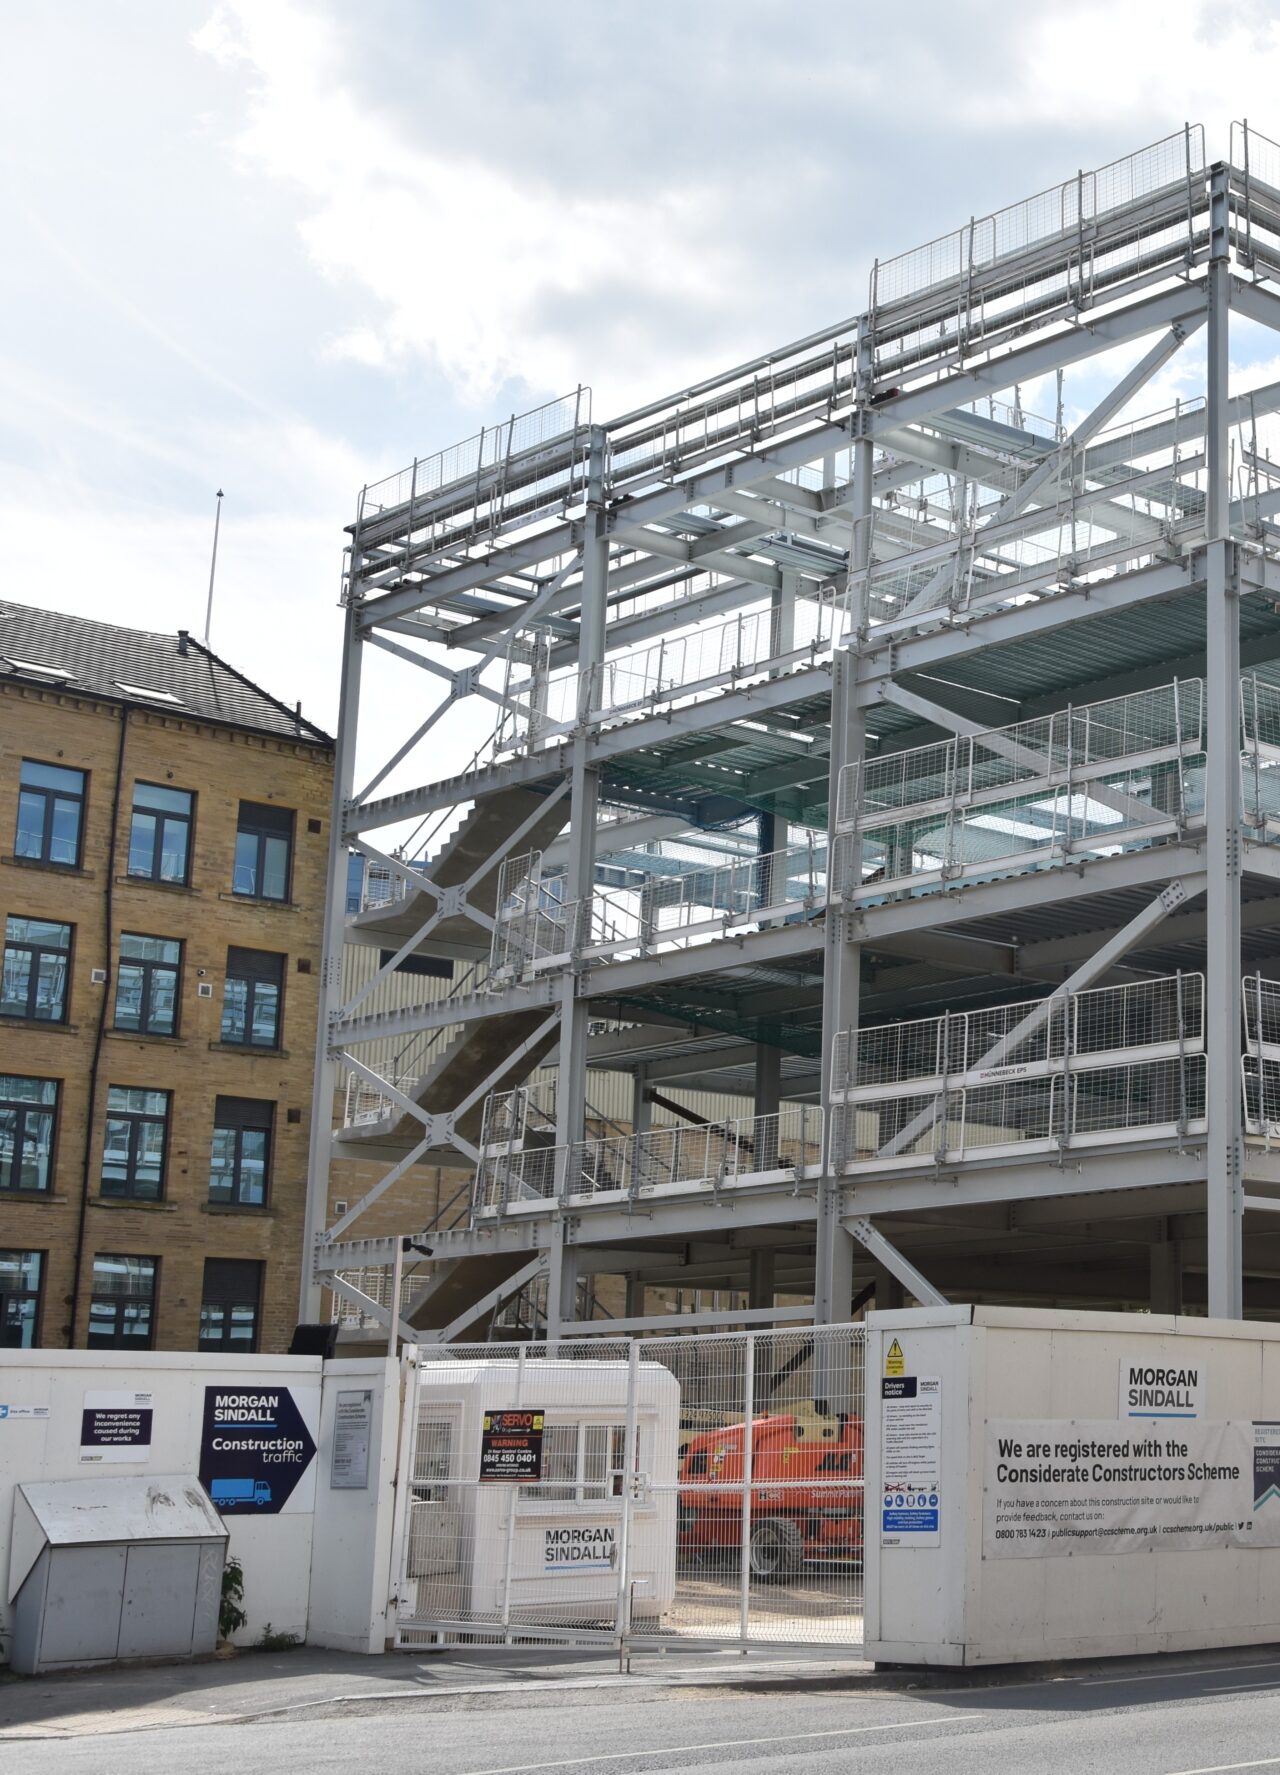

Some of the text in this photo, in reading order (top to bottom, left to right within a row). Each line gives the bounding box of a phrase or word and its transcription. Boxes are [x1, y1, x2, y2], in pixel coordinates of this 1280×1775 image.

[1129, 1368, 1198, 1387] MORGAN
[884, 1382, 905, 1390] Drivers
[215, 1396, 279, 1407] MORGAN
[1128, 1389, 1194, 1407] SINDALL
[107, 1413, 128, 1421] regret
[214, 1409, 275, 1421] SINDALL
[502, 1413, 532, 1427] SERVO
[212, 1438, 304, 1450] Construction
[491, 1439, 529, 1448] WARNING
[263, 1450, 303, 1463] traffic
[998, 1439, 1188, 1462] We are registered with the
[483, 1453, 537, 1463] 0845 450 0401
[997, 1463, 1240, 1483] Considerate Constructors Scheme
[996, 1495, 1200, 1510] If you have a concern about this construction site or would like to
[996, 1512, 1105, 1524] provide feedback, contact us on:
[545, 1528, 615, 1544] MORGAN
[995, 1529, 1015, 1539] 0800
[1016, 1529, 1028, 1539] 783
[1028, 1528, 1047, 1538] 1423
[544, 1545, 611, 1562] SINDALL
